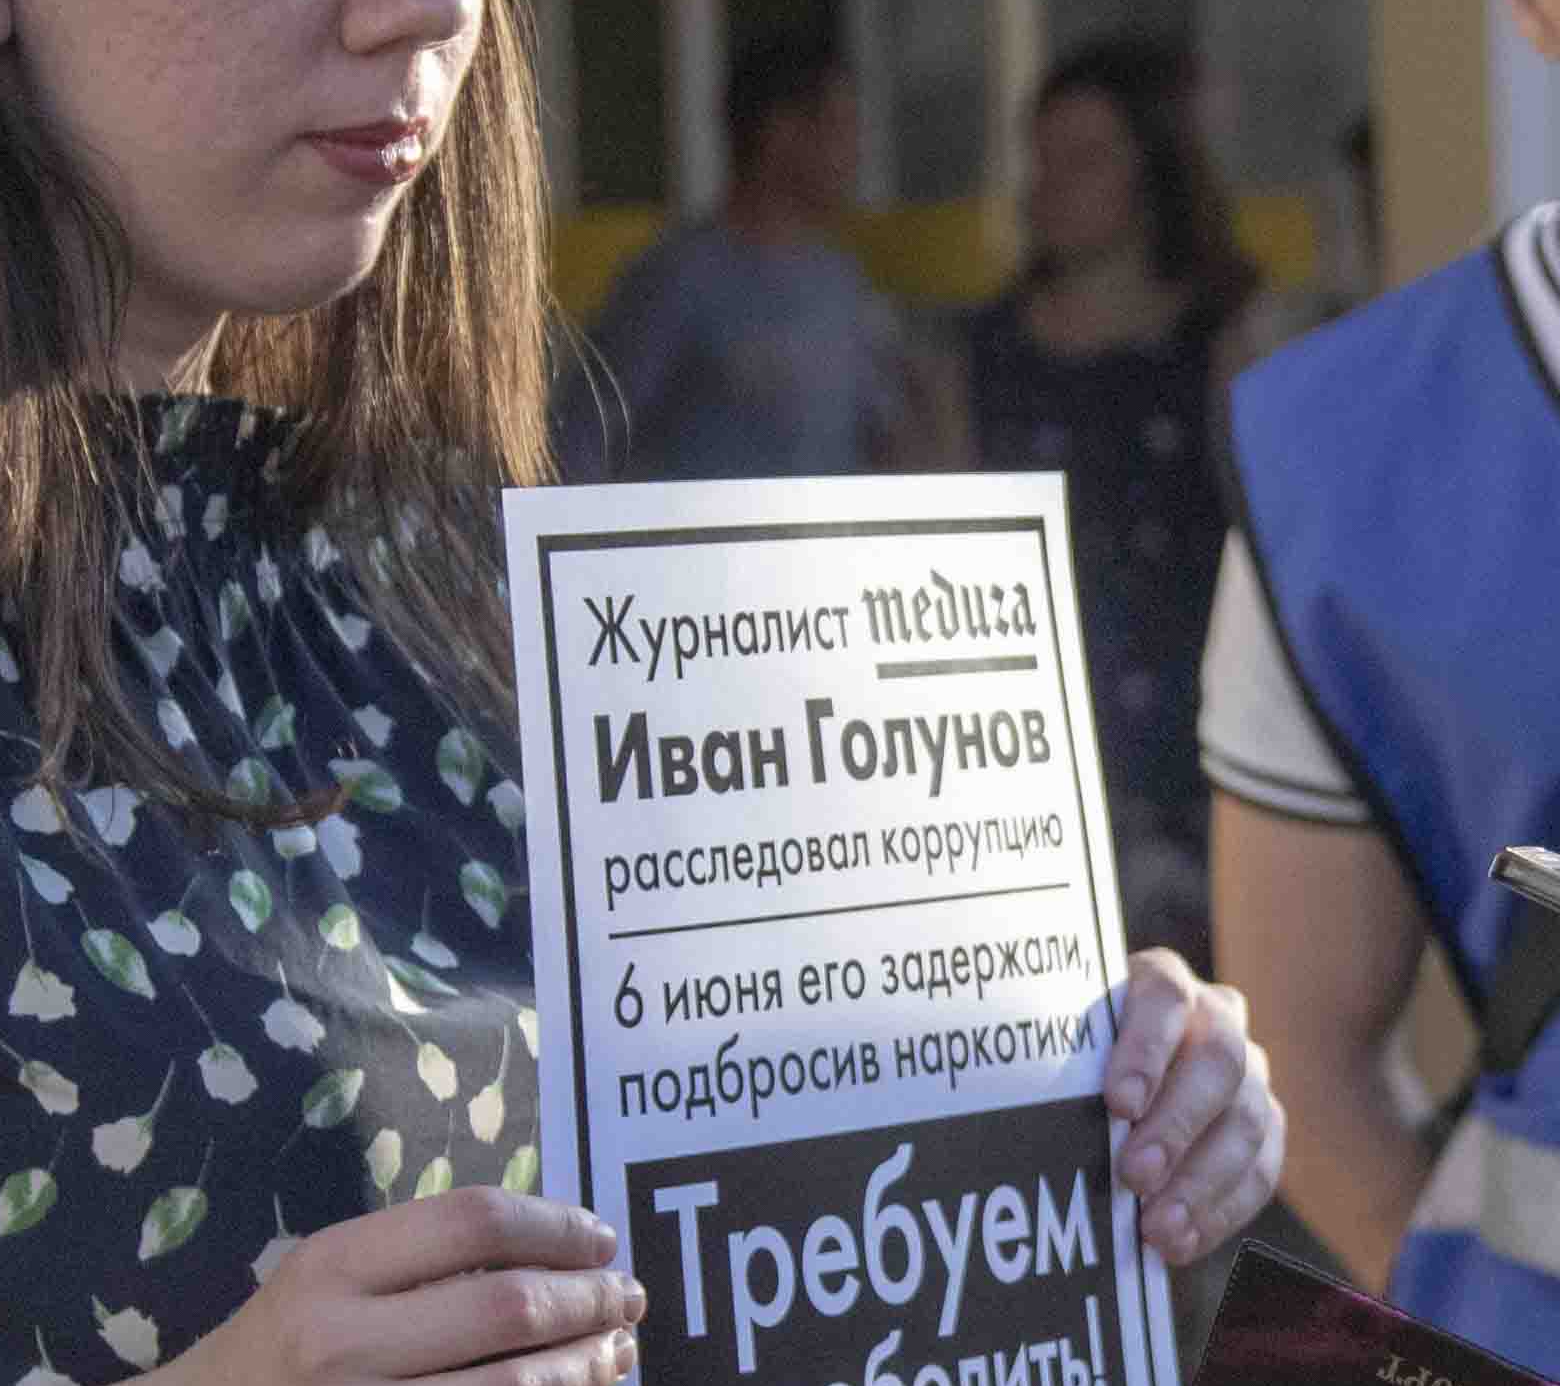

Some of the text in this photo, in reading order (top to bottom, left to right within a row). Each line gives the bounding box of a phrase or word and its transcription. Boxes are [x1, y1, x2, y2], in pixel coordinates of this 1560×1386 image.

[583, 594, 849, 681] Журналист
[592, 696, 1051, 803] Иван Голунов
[603, 812, 1065, 911] расследовал коррупцию
[613, 930, 1093, 1029] 6 июня его задержали,
[620, 1014, 1096, 1118] подбросив наркотики
[653, 1143, 1096, 1373] Требуем
